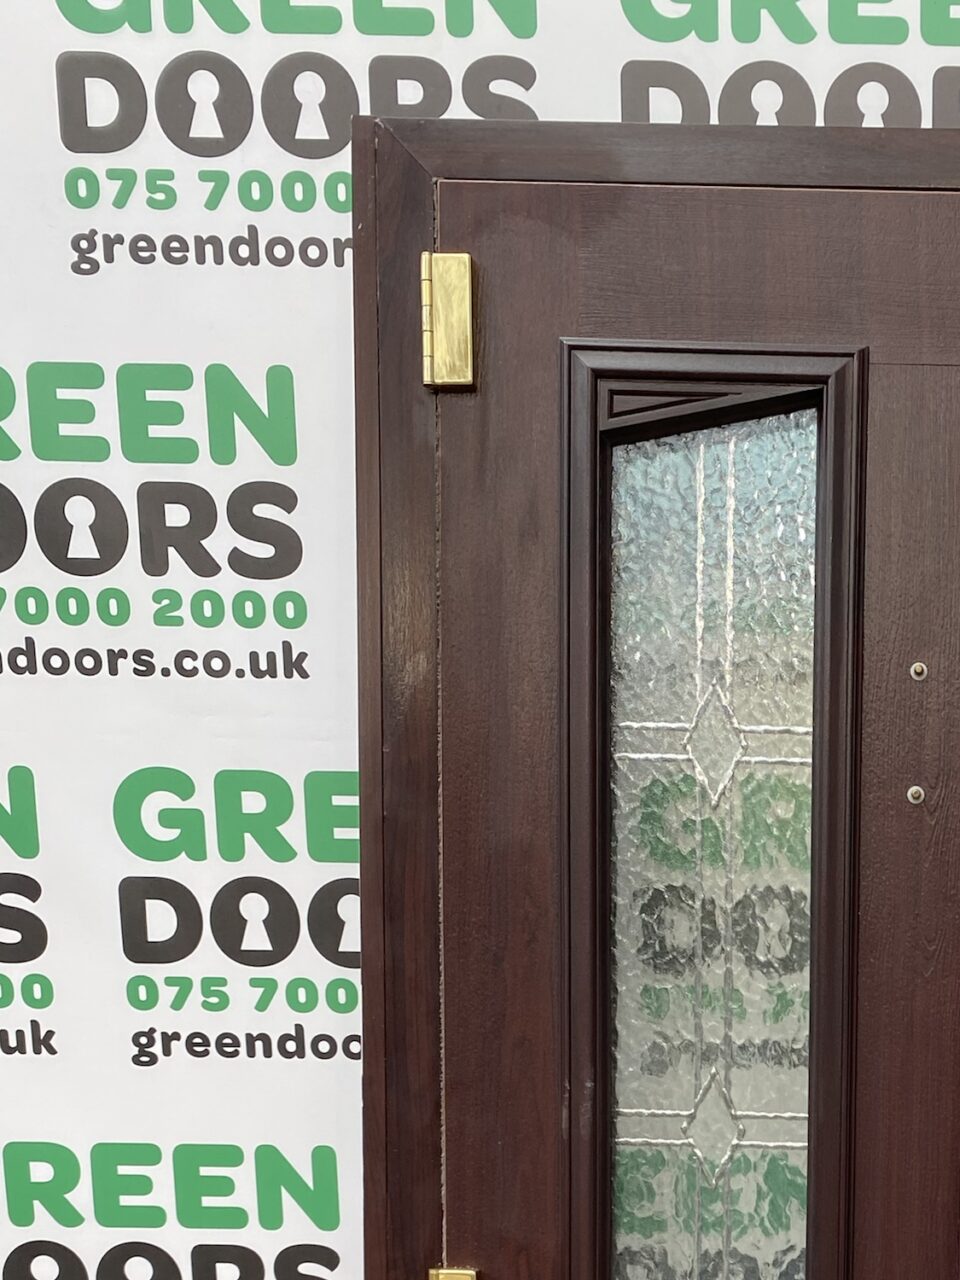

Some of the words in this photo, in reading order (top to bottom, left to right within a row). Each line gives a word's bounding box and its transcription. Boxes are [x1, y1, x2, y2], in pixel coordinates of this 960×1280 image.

[65, 166, 177, 211] 075
[197, 170, 352, 213] 7000
[0, 361, 298, 467] EEN
[0, 478, 302, 580] ORS
[0, 586, 132, 628] 000
[152, 587, 308, 629] 2000
[0, 637, 310, 679] doors.co.uk
[126, 975, 231, 1012] 075
[249, 976, 359, 1014] 700
[2, 1140, 341, 1232] REEN
